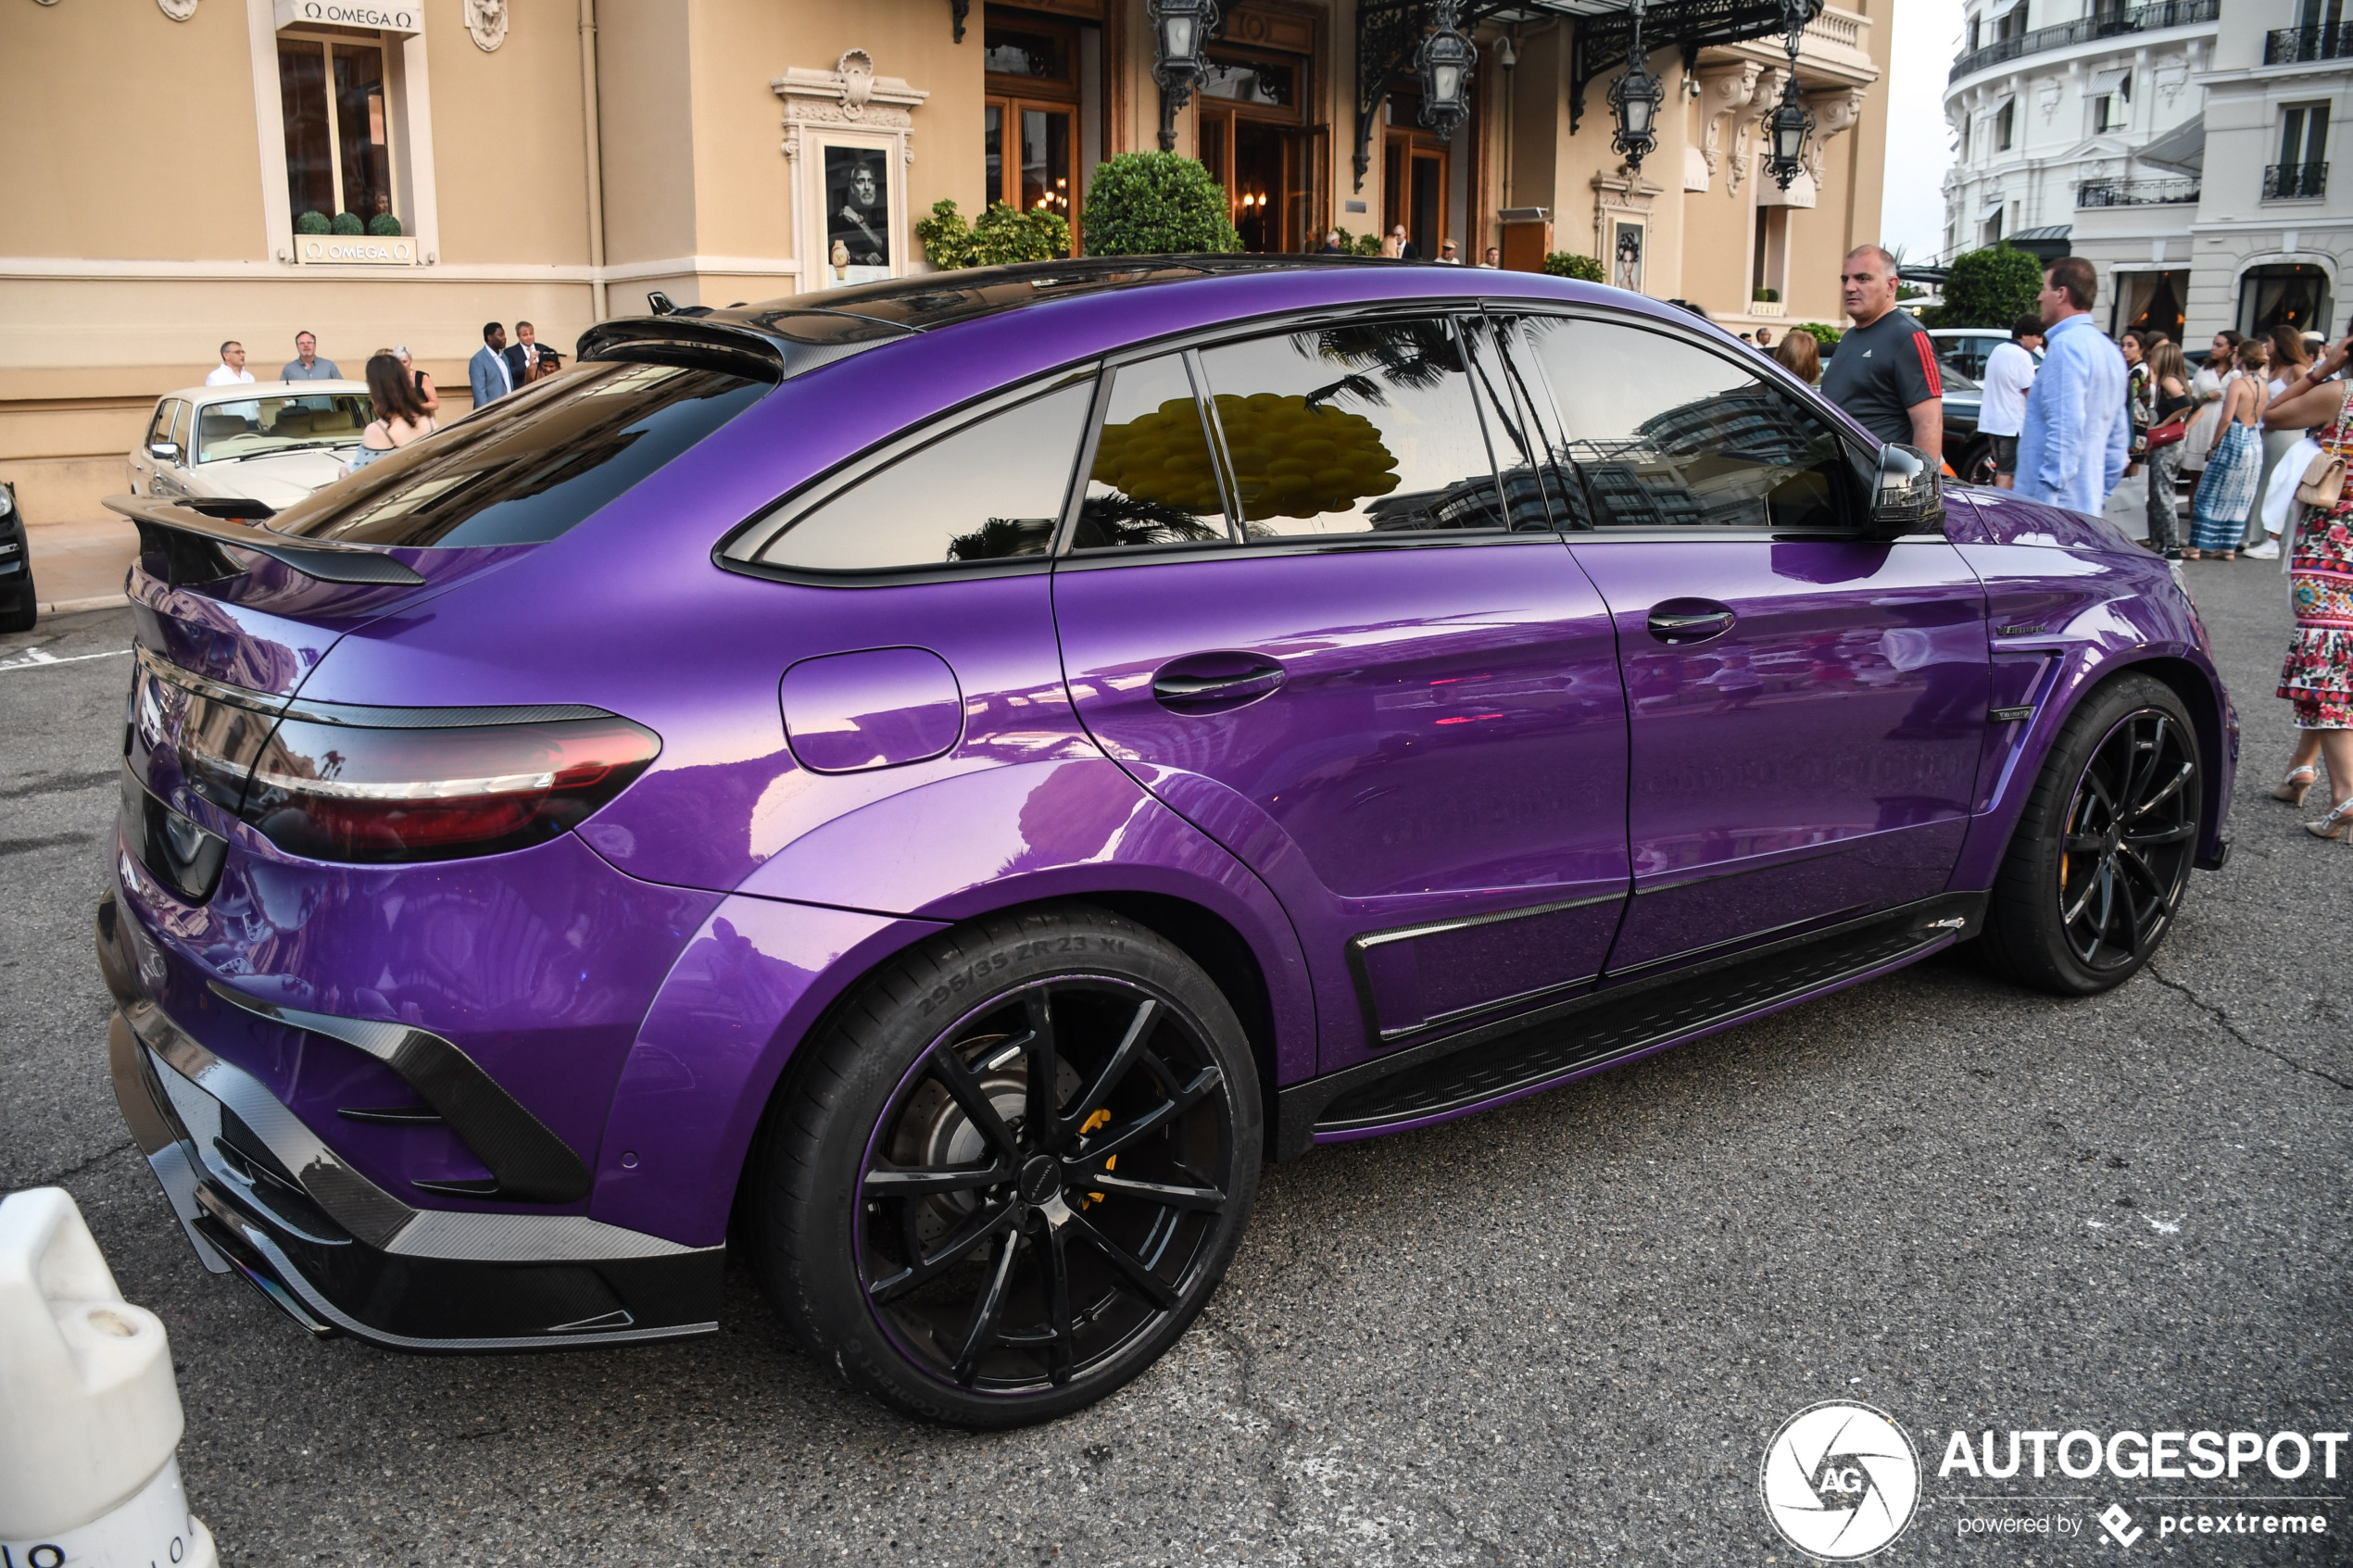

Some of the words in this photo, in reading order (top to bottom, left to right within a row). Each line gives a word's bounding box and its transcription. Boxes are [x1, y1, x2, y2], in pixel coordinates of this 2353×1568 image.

[327, 6, 392, 26] OMEGA
[328, 244, 389, 260] OMEGA
[917, 952, 1010, 1018] 295/35
[1014, 939, 1051, 961] ZR
[1056, 936, 1088, 953] 23
[1100, 937, 1132, 957] XL
